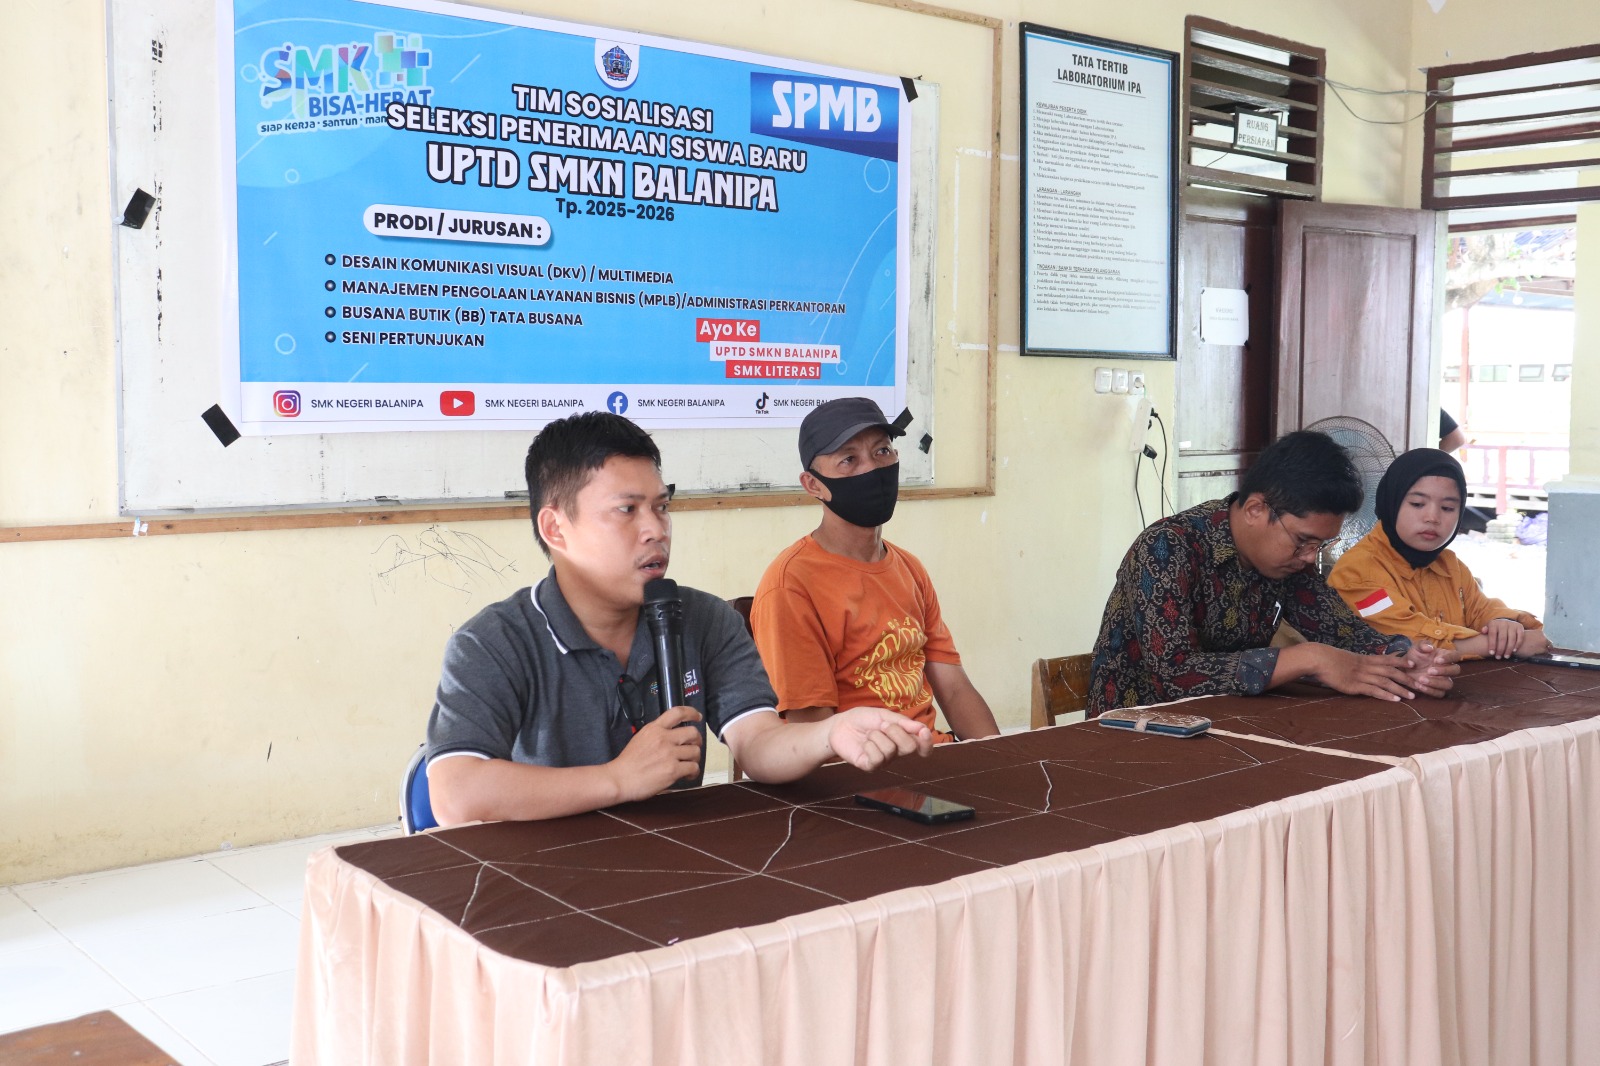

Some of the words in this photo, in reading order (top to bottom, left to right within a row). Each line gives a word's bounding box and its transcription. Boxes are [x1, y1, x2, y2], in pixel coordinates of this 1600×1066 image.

[1072, 54, 1094, 69] TATA
[1097, 58, 1128, 75] TERTIB
[261, 44, 372, 110] SMK
[1057, 68, 1125, 91] LABORATORIUM
[1128, 81, 1142, 94] IPA
[512, 83, 562, 114] TIM
[565, 91, 713, 133] SOSIALISASI
[771, 80, 882, 133] SPMB
[1246, 119, 1269, 132] RUANG
[386, 101, 496, 140] SELEKSI
[500, 114, 667, 158] PENERIMAAN
[670, 135, 746, 166] SISWA
[749, 144, 807, 173] BARU
[1238, 133, 1275, 148] PERSIAPAN
[426, 141, 521, 189] UPTD
[528, 151, 625, 198] SMKN
[632, 162, 779, 213] BALANIPA
[555, 198, 582, 218] Tp.
[585, 200, 675, 221] 2025-2026
[374, 212, 433, 232] PRODI
[342, 255, 397, 270] DESAIN
[401, 258, 493, 274] KOMUNIKASI
[496, 263, 544, 278] VISUAL
[547, 263, 587, 282] (DKV)
[598, 269, 674, 284] MULTIMEDIA
[342, 280, 438, 297] MANAJEMEN
[442, 284, 527, 300] PENGOLAAN
[530, 289, 593, 303] LAYANAN
[595, 292, 636, 305] BISNIS
[769, 300, 846, 314] PERKANTORAN
[342, 306, 406, 320] BUSANA
[409, 308, 451, 321] BUTIK
[455, 306, 486, 326] (BB)
[489, 311, 526, 324] TATA
[528, 312, 583, 326] BUSANA
[342, 331, 376, 345] SENI
[379, 332, 485, 347] PERTUNJUKAN
[699, 320, 733, 341] Ayo
[736, 321, 757, 337] Ke
[715, 346, 746, 357] UPTD
[749, 347, 782, 358] SMKN
[785, 348, 838, 359] BALANIPA
[733, 364, 762, 376] SMK
[765, 365, 820, 377] LITERASI
[311, 399, 334, 408] SMK
[336, 399, 372, 408] NEGERI
[375, 399, 424, 408] BALANIPA
[485, 399, 505, 408] SMK
[507, 399, 539, 408] NEGERI
[541, 399, 585, 408] BALANIPA
[637, 399, 655, 407] SMK
[658, 399, 685, 407] NEGERI
[687, 399, 726, 407] BALANIPA
[773, 399, 789, 407] SMK
[790, 399, 814, 407] NEGERI
